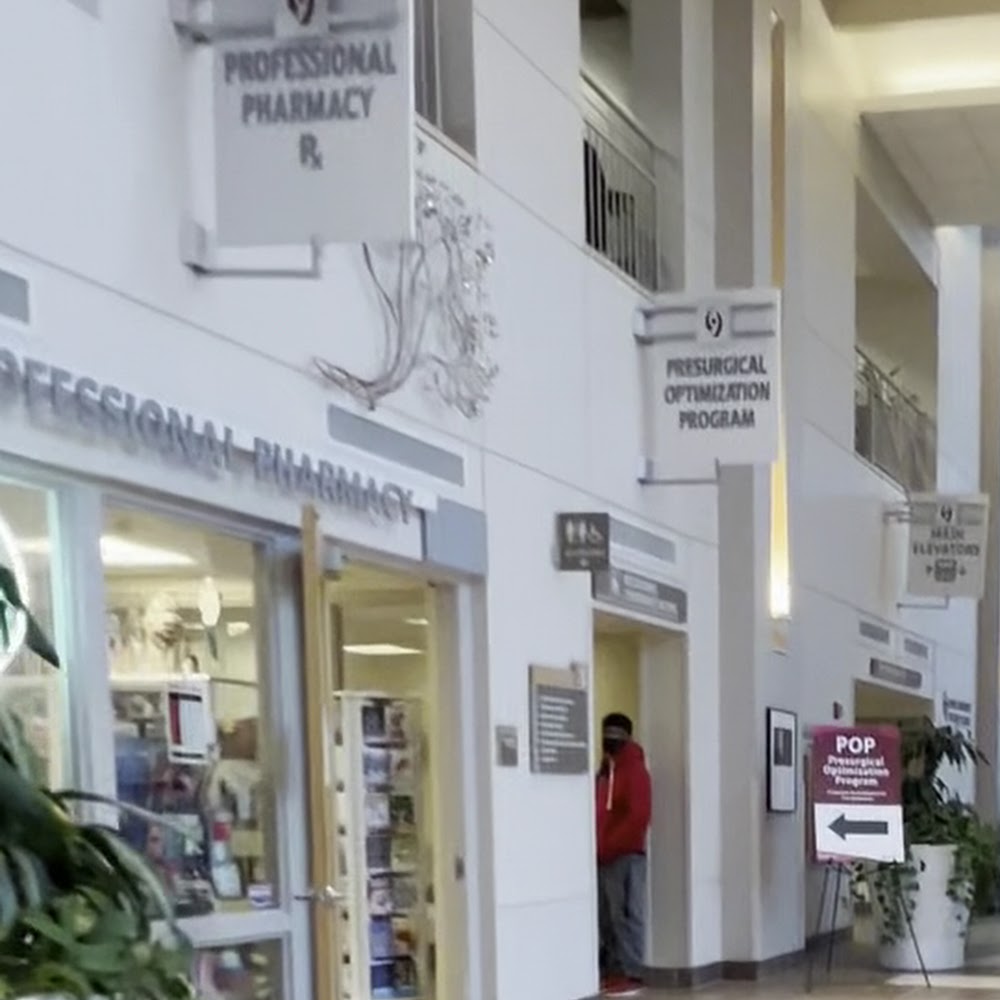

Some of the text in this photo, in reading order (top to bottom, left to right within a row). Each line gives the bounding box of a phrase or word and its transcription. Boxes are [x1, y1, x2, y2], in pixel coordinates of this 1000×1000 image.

[224, 40, 396, 83] PROFESSIONAL
[241, 86, 374, 124] PHARMACY
[666, 354, 767, 379] PRESURGICAL
[664, 381, 771, 404] OPTIMIZATION
[679, 408, 755, 429] PROGRAM
[254, 437, 414, 524] PHARMACY
[931, 526, 965, 540] MAIN
[913, 542, 980, 557] ELEVATORS
[836, 735, 876, 754] POP
[827, 754, 885, 768] Presurgical
[835, 775, 879, 788] Program
